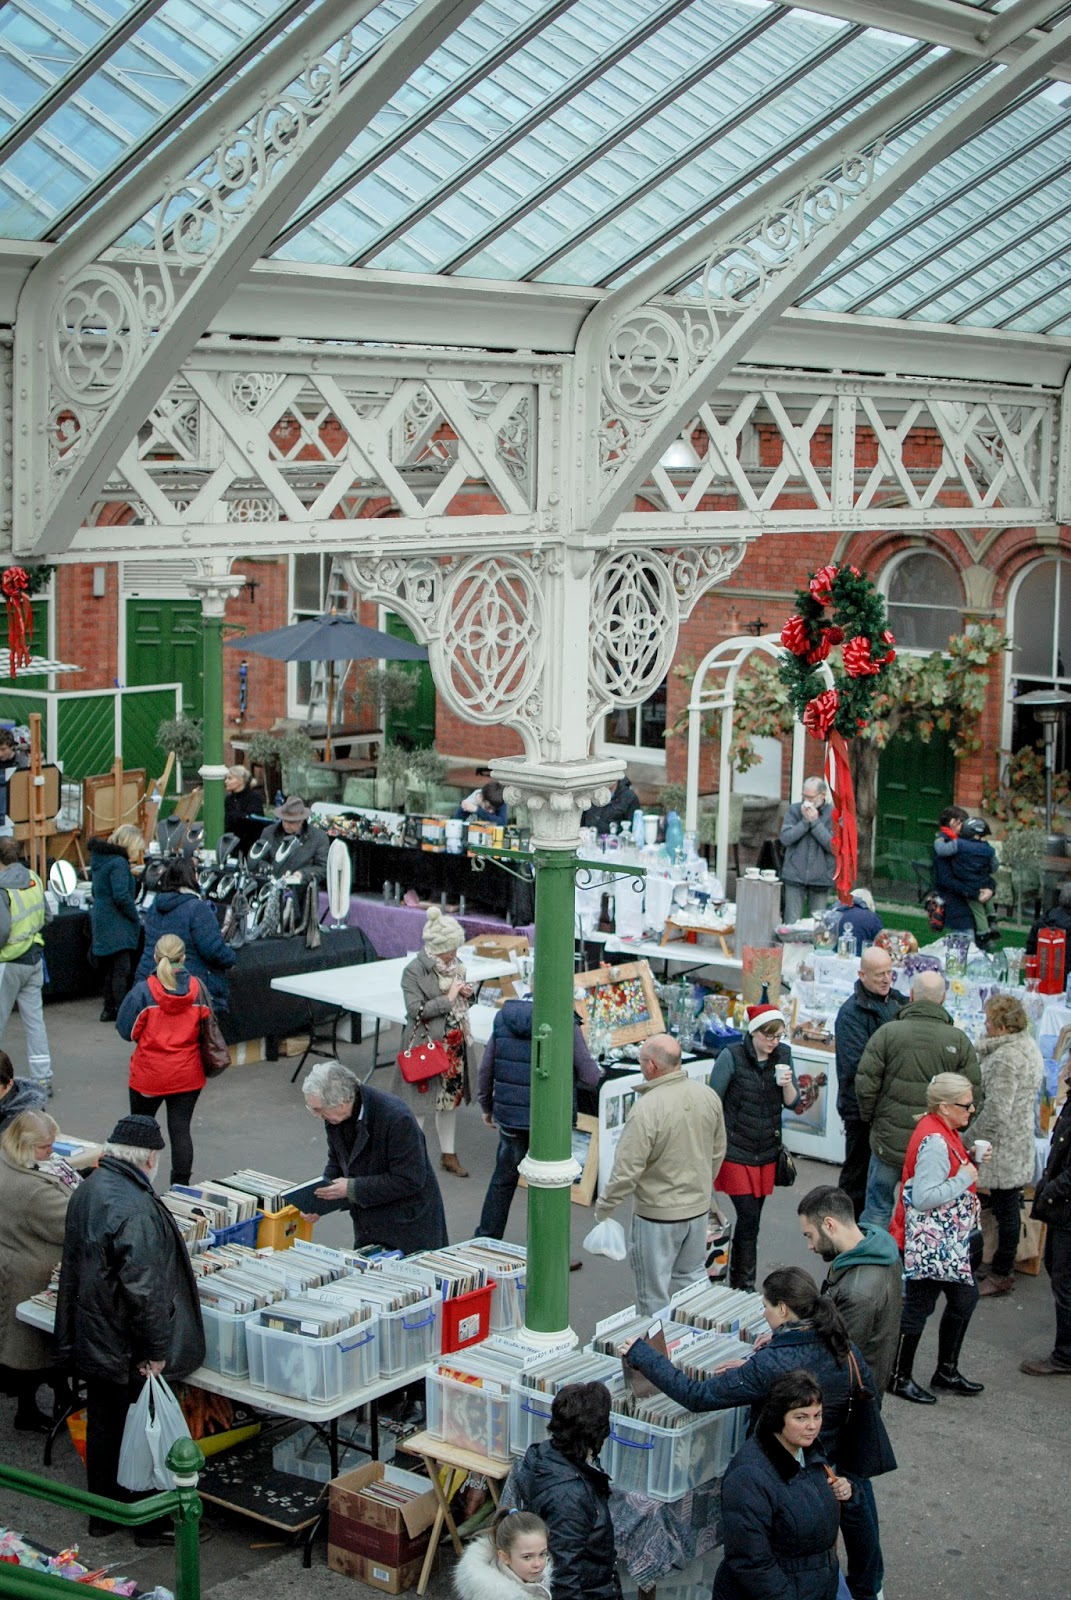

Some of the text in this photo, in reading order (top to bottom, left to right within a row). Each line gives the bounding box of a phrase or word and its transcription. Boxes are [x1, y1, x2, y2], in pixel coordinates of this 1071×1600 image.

[390, 1262, 421, 1276] SIXTIES
[319, 1293, 344, 1305] ELVIS
[460, 1470, 489, 1494] fresh
